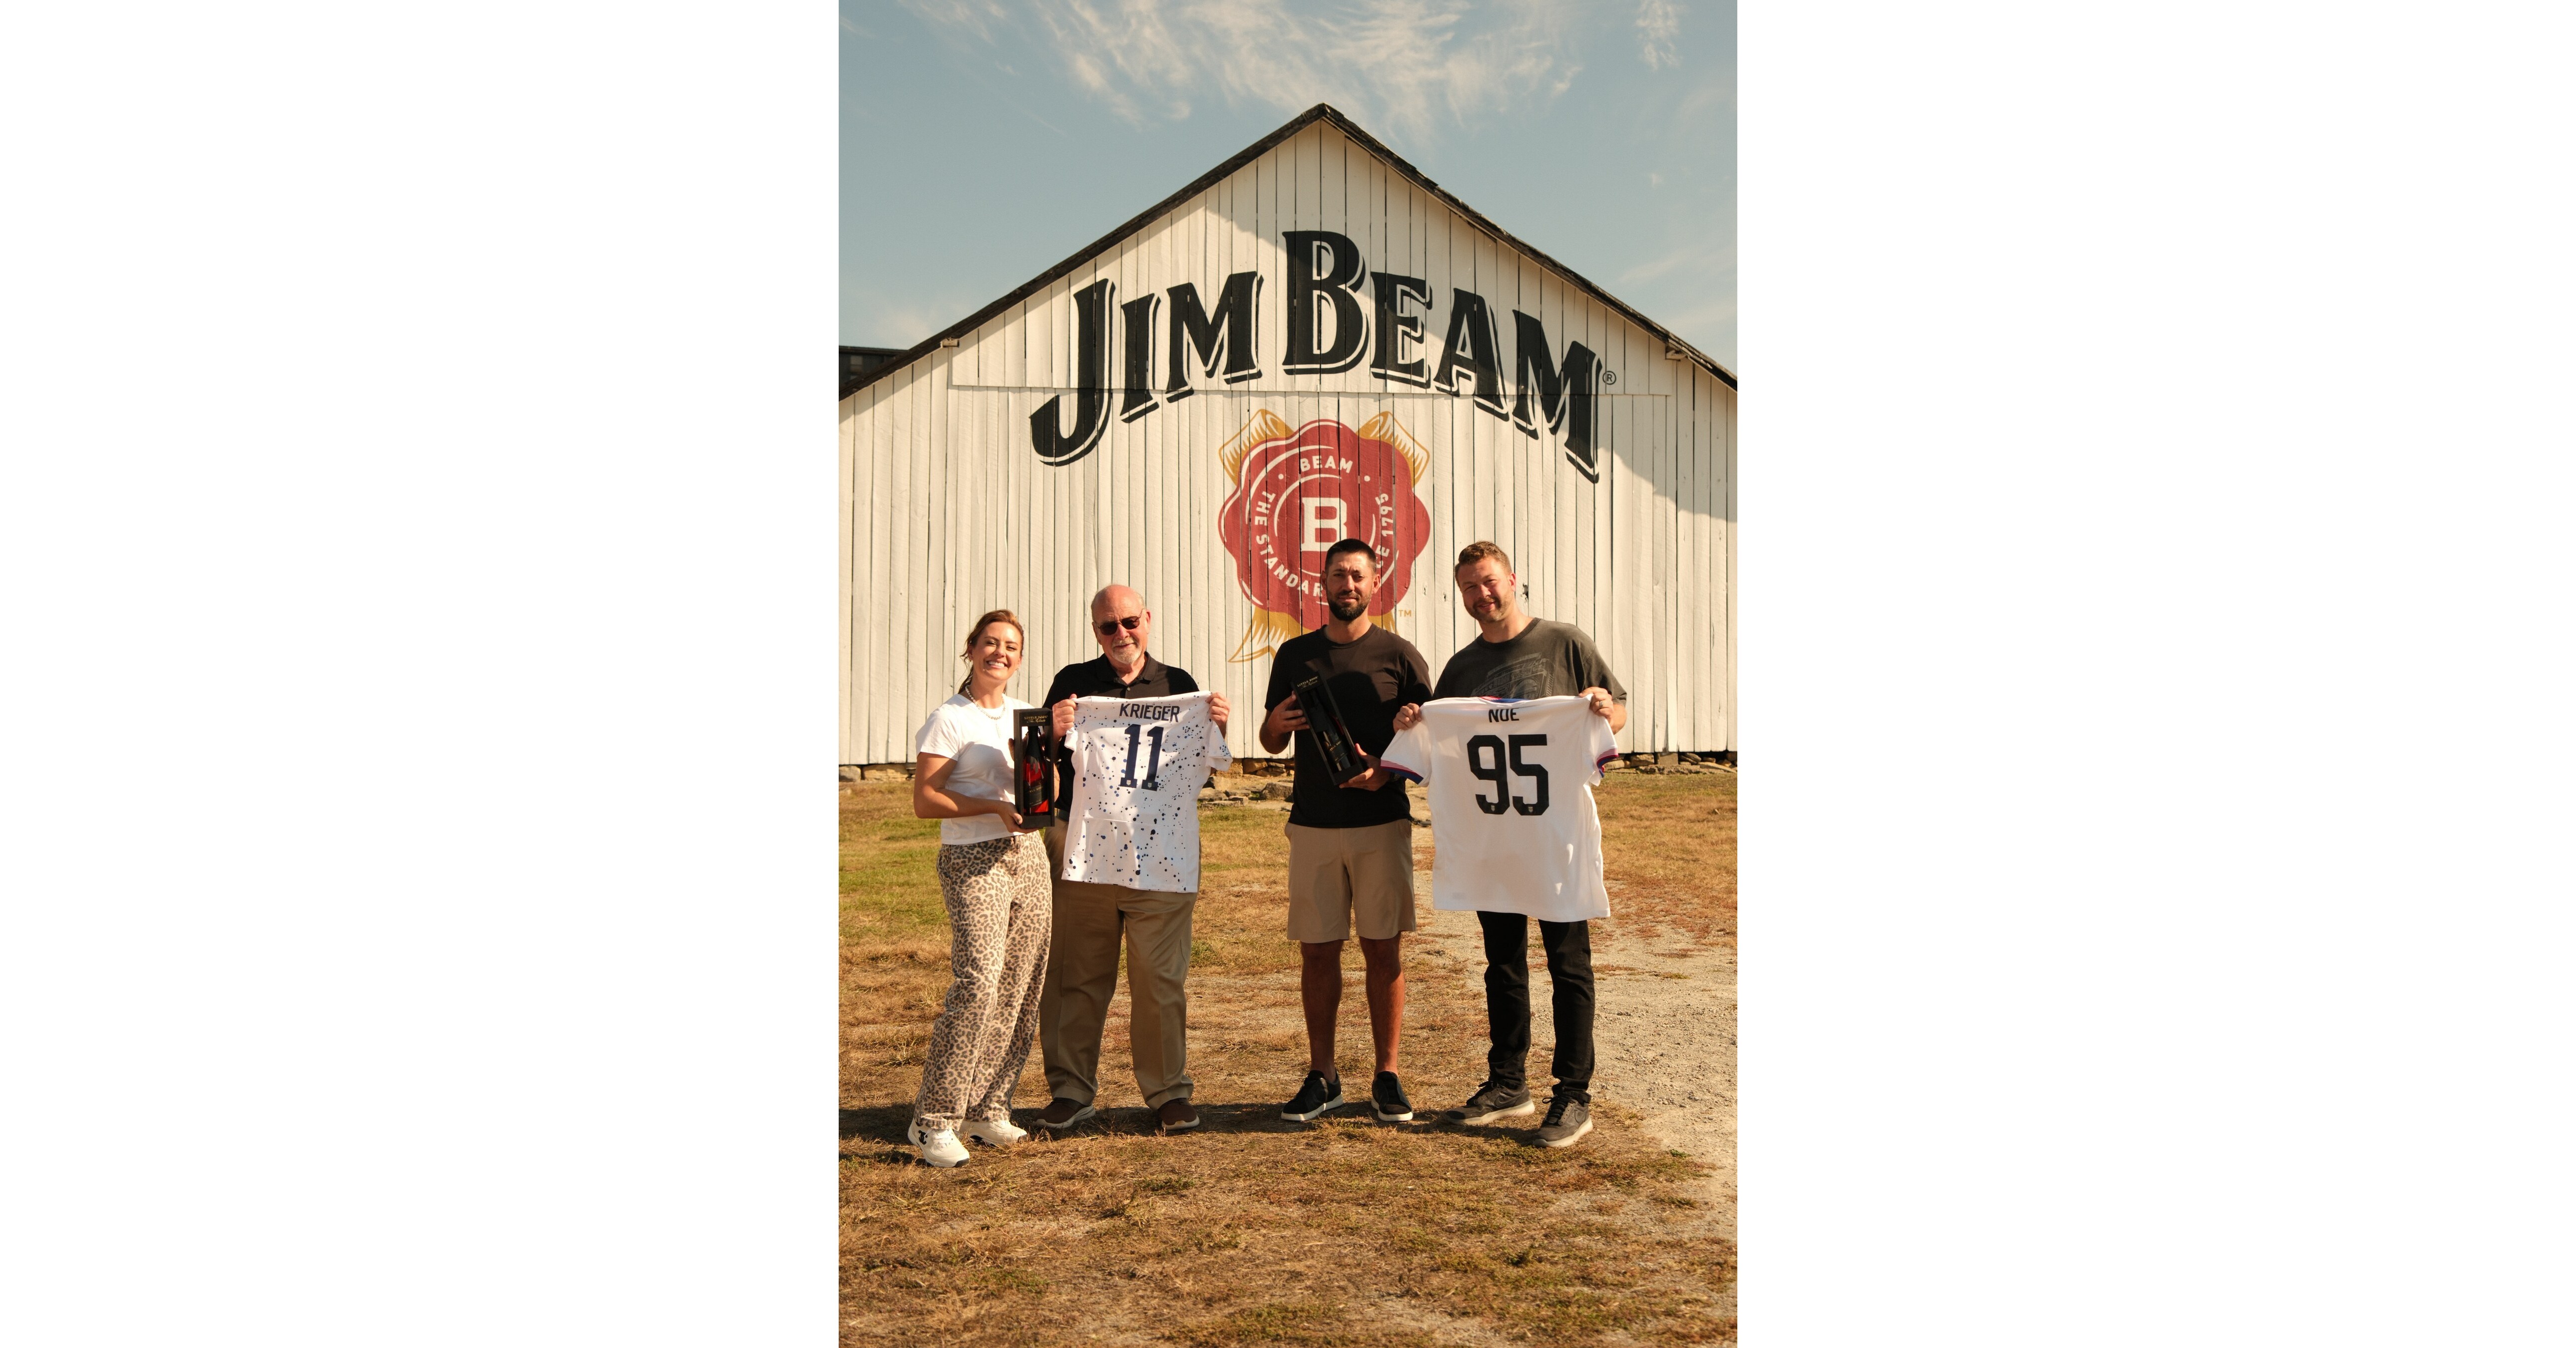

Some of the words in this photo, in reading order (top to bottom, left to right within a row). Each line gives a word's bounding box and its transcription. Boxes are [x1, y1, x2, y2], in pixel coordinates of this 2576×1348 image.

[1030, 271, 1264, 467] JIM
[1300, 455, 1353, 473] BEAM
[1254, 491, 1276, 526] THE
[1301, 497, 1347, 552] B
[1375, 493, 1394, 537] 1795
[1256, 534, 1323, 597] STANDAR
[1119, 703, 1180, 723] KRIEGER
[1488, 707, 1520, 723] NOE
[1120, 724, 1164, 792] 11
[1467, 734, 1549, 816] 95
